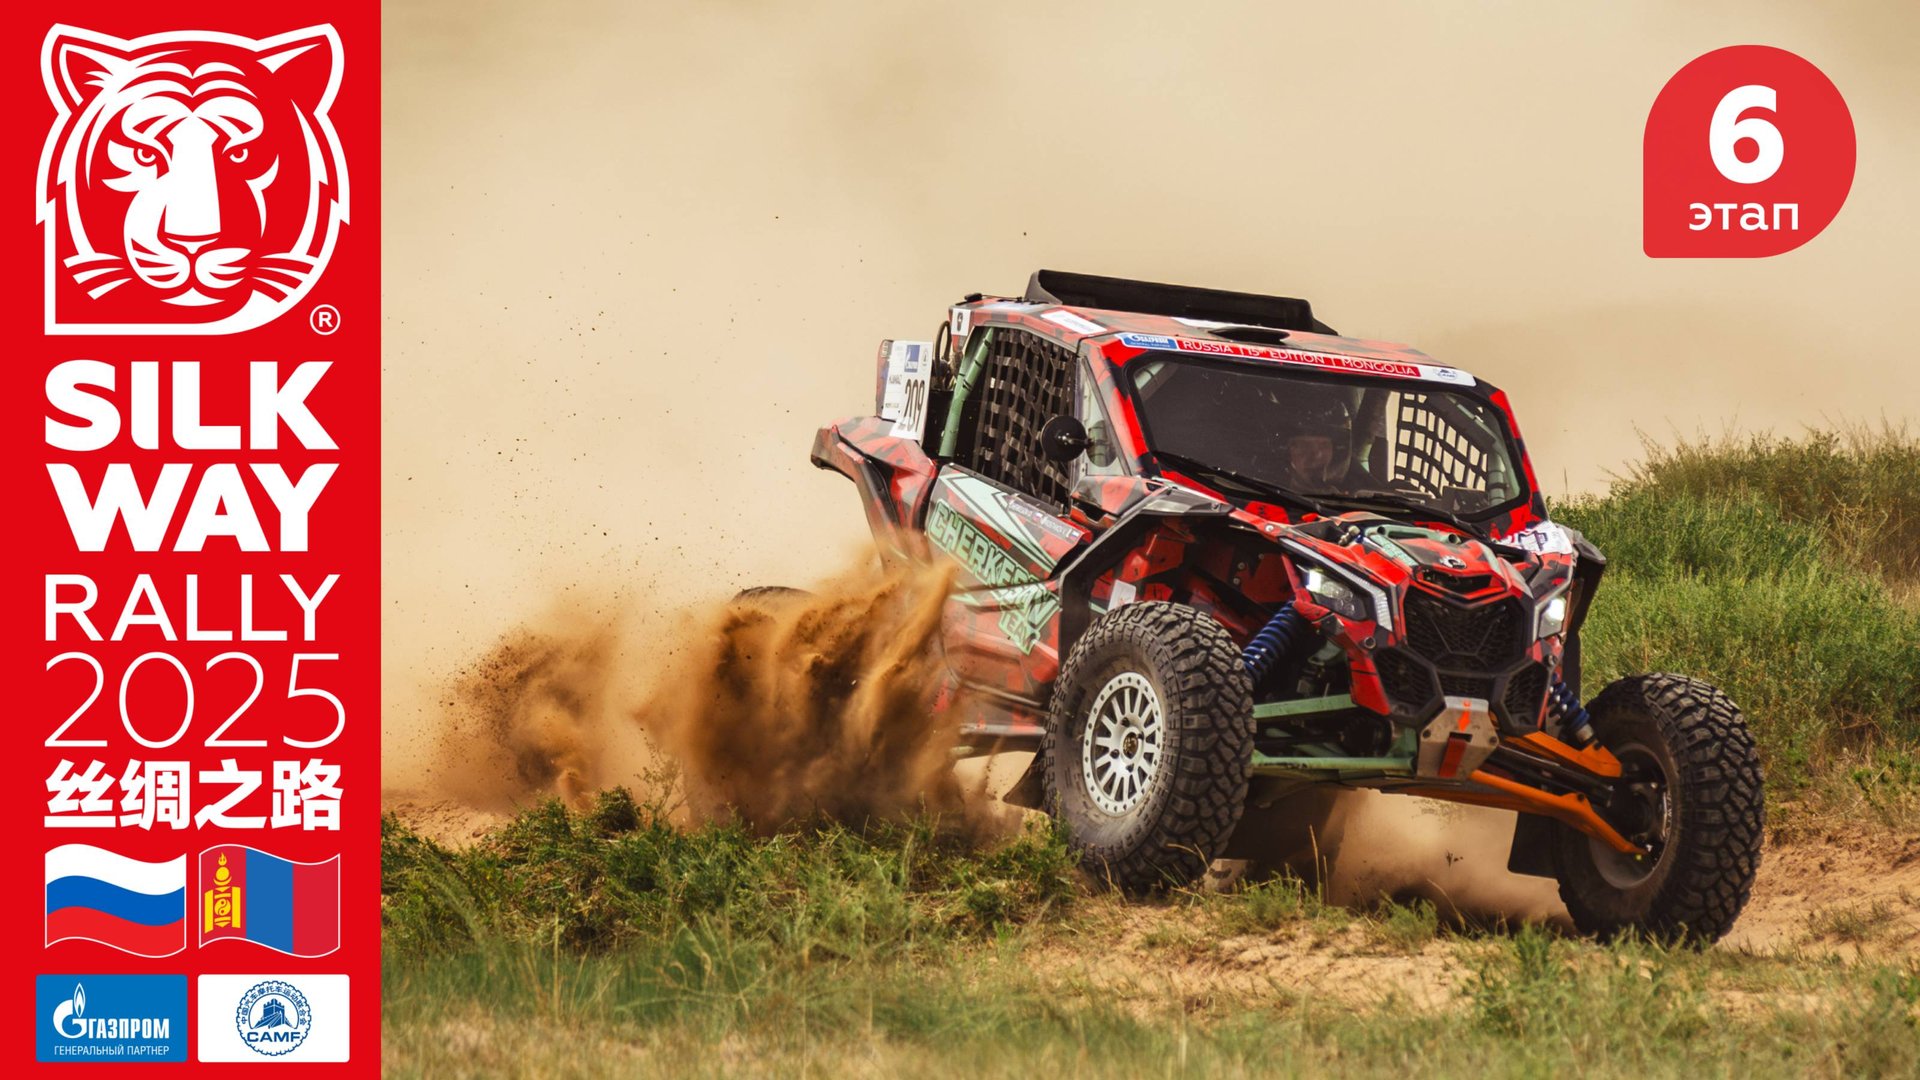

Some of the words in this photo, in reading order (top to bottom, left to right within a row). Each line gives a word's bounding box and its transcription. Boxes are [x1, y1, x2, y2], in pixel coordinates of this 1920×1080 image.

[1183, 340, 1233, 354] RUSSIA
[1269, 349, 1324, 365] EDITION
[1341, 357, 1416, 376] MONGOLIA
